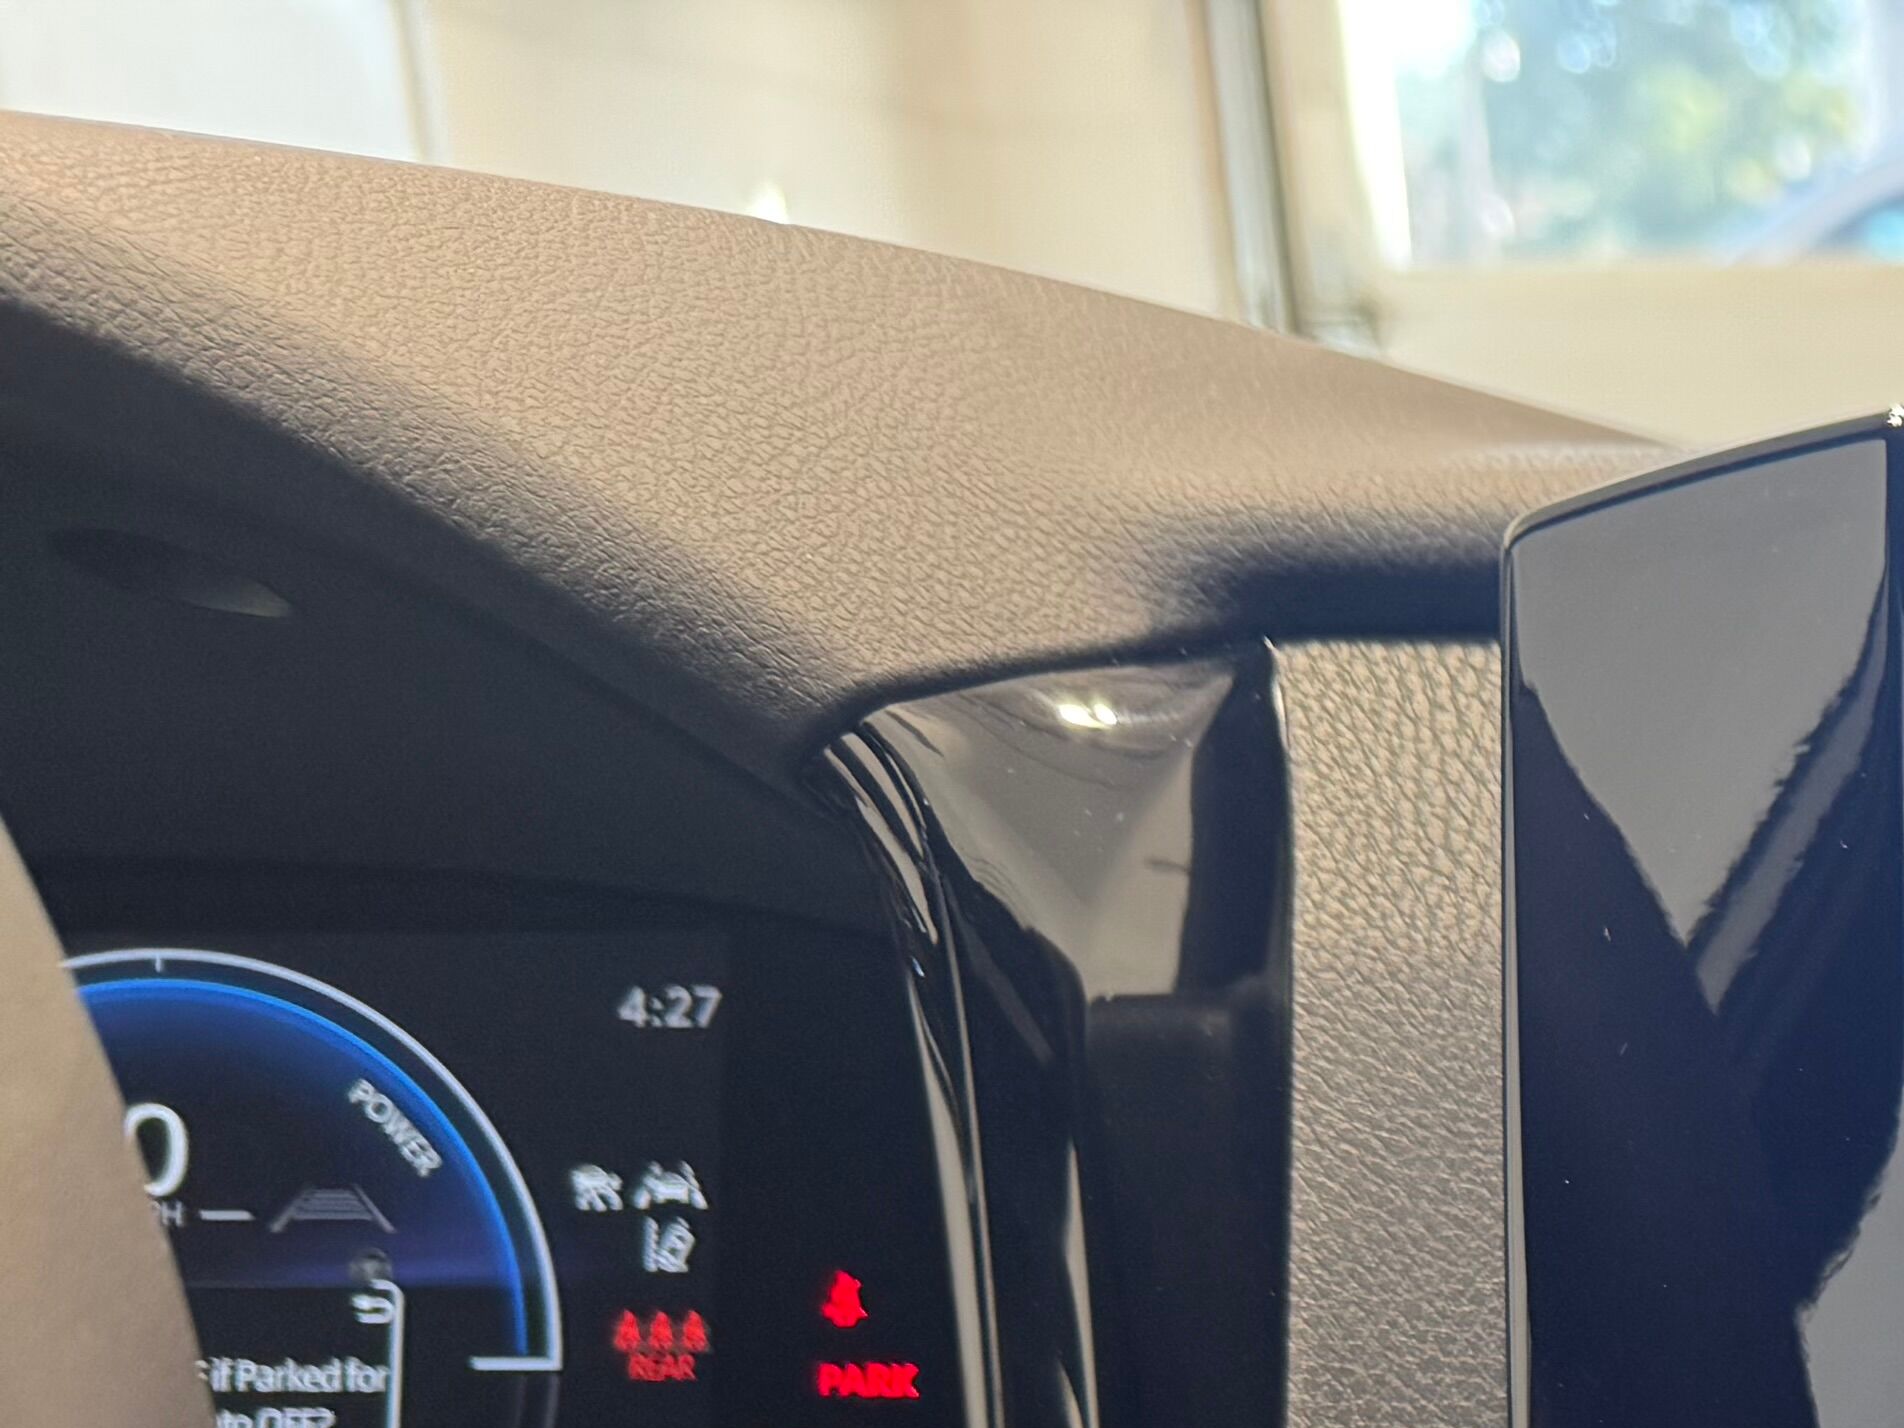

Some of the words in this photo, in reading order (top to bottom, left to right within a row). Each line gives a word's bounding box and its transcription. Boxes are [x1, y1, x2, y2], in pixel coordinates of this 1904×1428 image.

[617, 984, 723, 1029] 4:27
[347, 1077, 443, 1179] POWER
[209, 1356, 233, 1392] if
[235, 1356, 341, 1393] Parked
[344, 1356, 390, 1392] for
[628, 1353, 697, 1382] REAR
[816, 1361, 921, 1399] PARK
